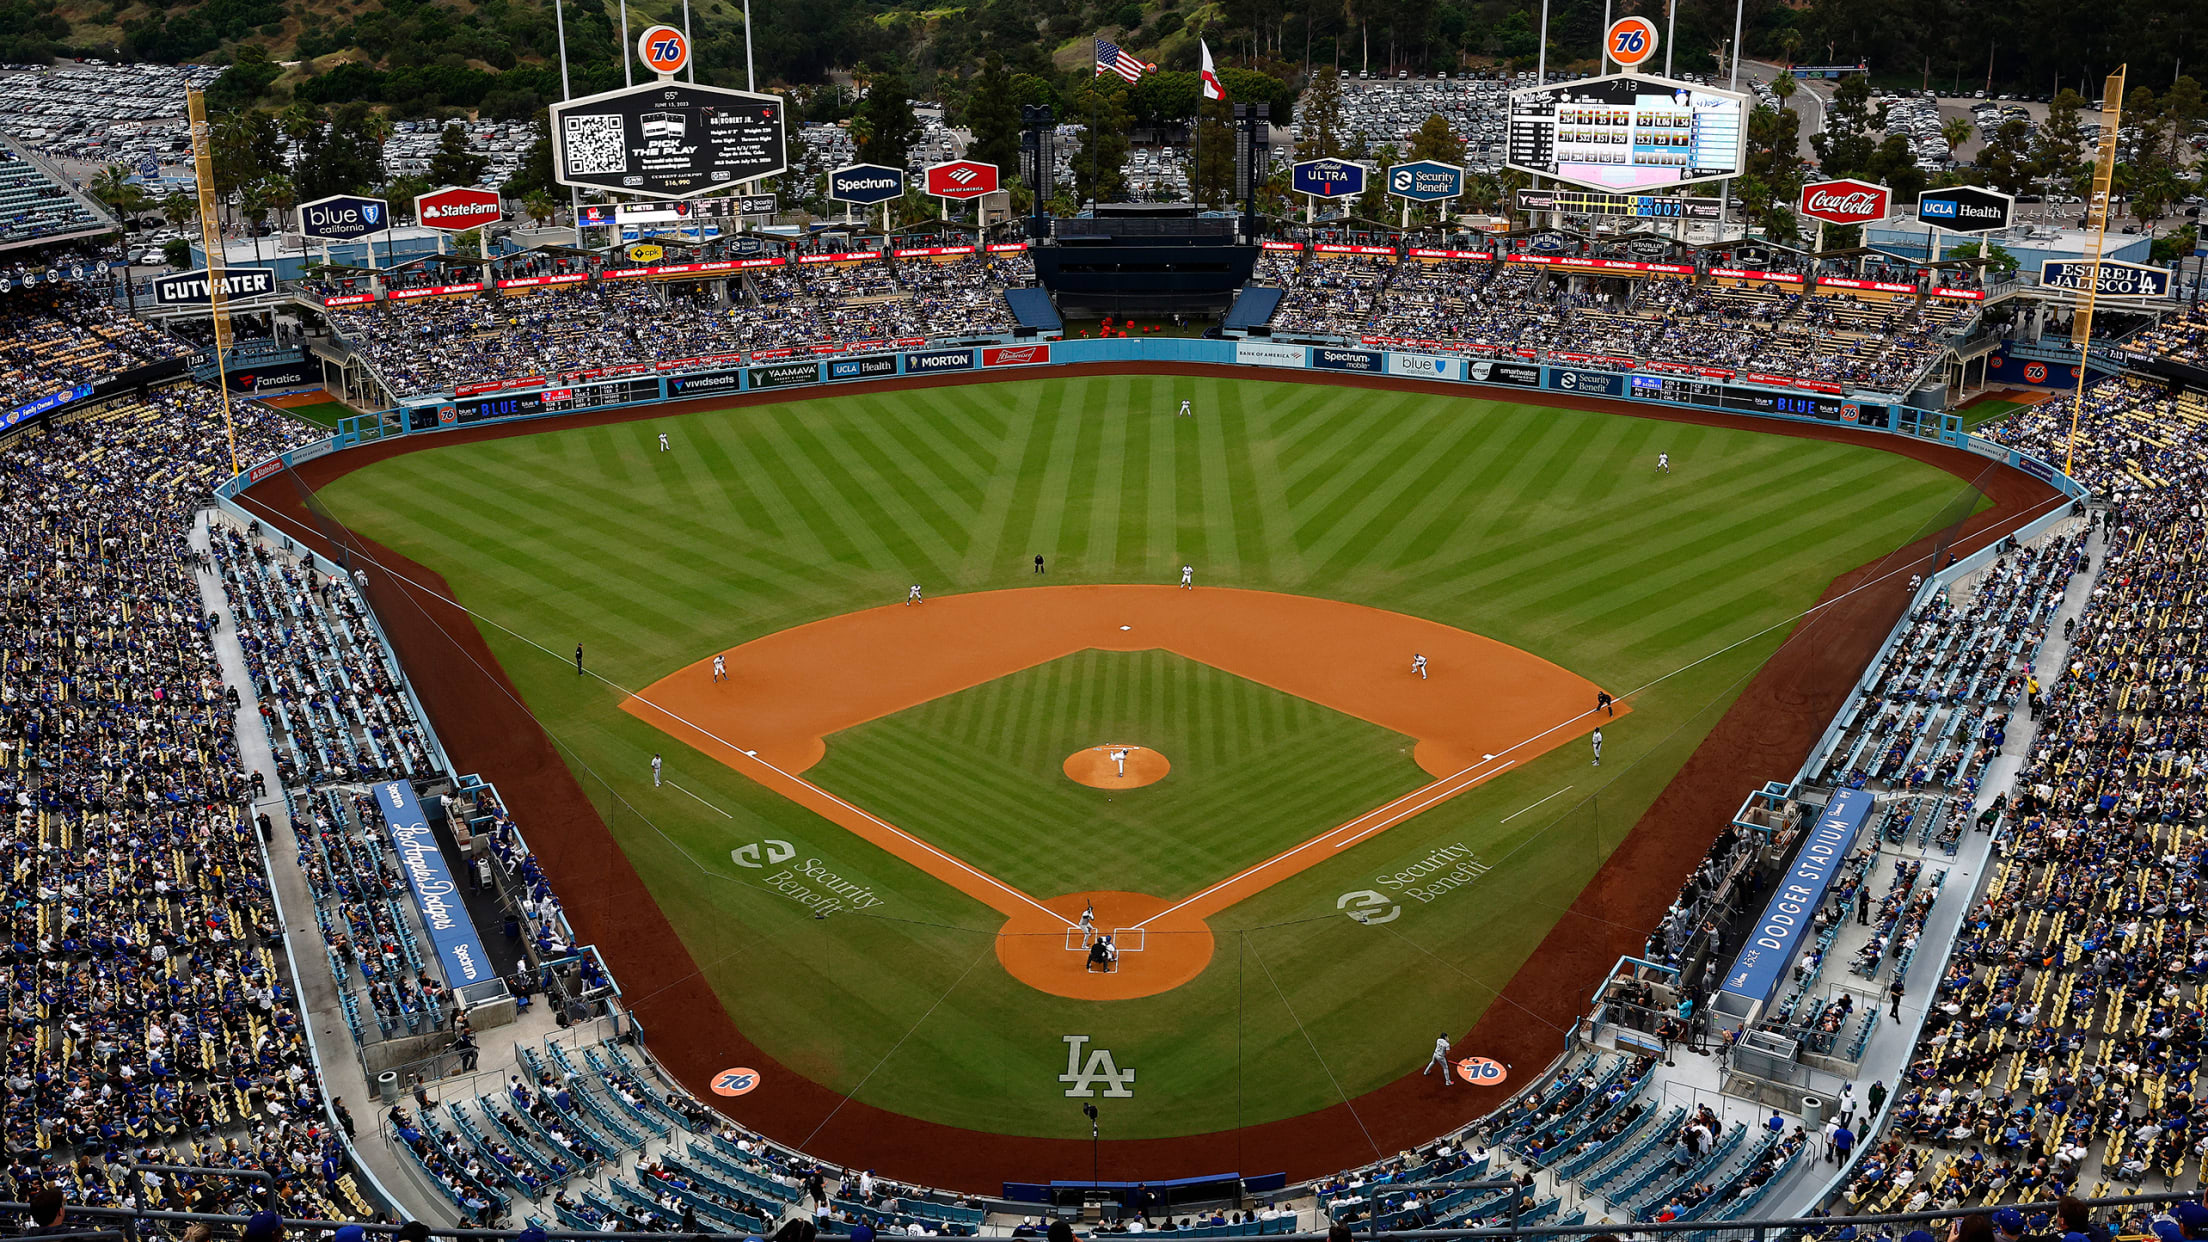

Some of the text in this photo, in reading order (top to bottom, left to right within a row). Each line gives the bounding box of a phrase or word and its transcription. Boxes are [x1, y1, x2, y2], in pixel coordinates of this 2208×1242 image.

[1614, 30, 1645, 53] 76
[651, 38, 681, 62] 76
[1611, 80, 1638, 91] 7:13
[1640, 117, 1650, 125] 0-2
[648, 140, 680, 148] PICK
[663, 146, 698, 155] PLAY
[1308, 170, 1348, 181] ULTRA
[1416, 171, 1454, 183] Security
[837, 178, 894, 192] Spectrum
[1416, 182, 1449, 192] Benefit
[1808, 190, 1880, 215] Coca-Cola
[1654, 204, 1661, 215] 0
[1664, 204, 1671, 216] 0
[1674, 204, 1680, 216] 2
[1924, 203, 2000, 218] UCLA Health
[310, 207, 358, 226] blue
[320, 224, 364, 234] california
[1532, 234, 1562, 248] JIM BEAM
[1632, 242, 1663, 250] STARLUX
[2061, 264, 2138, 282] ESTREL
[24, 276, 34, 284] 42
[2051, 276, 2132, 293] JALISCO
[2138, 270, 2156, 294] LA
[164, 276, 266, 300] CUTWATER
[191, 356, 204, 364] 7:13
[922, 355, 968, 368] MORTON
[1324, 351, 1367, 363] Spectrum
[2110, 350, 2123, 360] 7:13
[2128, 352, 2147, 361] ROBERT
[836, 362, 891, 374] UCLA Health
[1403, 357, 1432, 369] blue
[768, 364, 816, 378] YAAMAVA'
[1407, 368, 1435, 376] california
[1500, 368, 1536, 376] smartwater
[2027, 366, 2044, 378] 76
[256, 374, 300, 387] Fanatics
[685, 375, 734, 388] vividseats
[1579, 373, 1611, 384] Security
[1579, 382, 1606, 392] Benefit
[37, 400, 54, 411] Owned
[481, 400, 518, 416] BLUE
[1778, 398, 1816, 414] BLUE
[442, 410, 454, 420] 76
[1844, 408, 1856, 418] 76
[386, 782, 404, 808] Spectrum
[1376, 842, 1474, 890] Security
[392, 822, 456, 930] Los Angeles Dodgers
[1404, 859, 1493, 903] Benefit
[794, 858, 884, 910] Security
[1757, 819, 1849, 950] DODGER STADIUM
[762, 870, 846, 918] Benefit
[452, 944, 477, 980] Spectrum
[1058, 1034, 1136, 1098] LA
[1464, 1062, 1500, 1080] 76
[714, 1074, 756, 1090] 76
